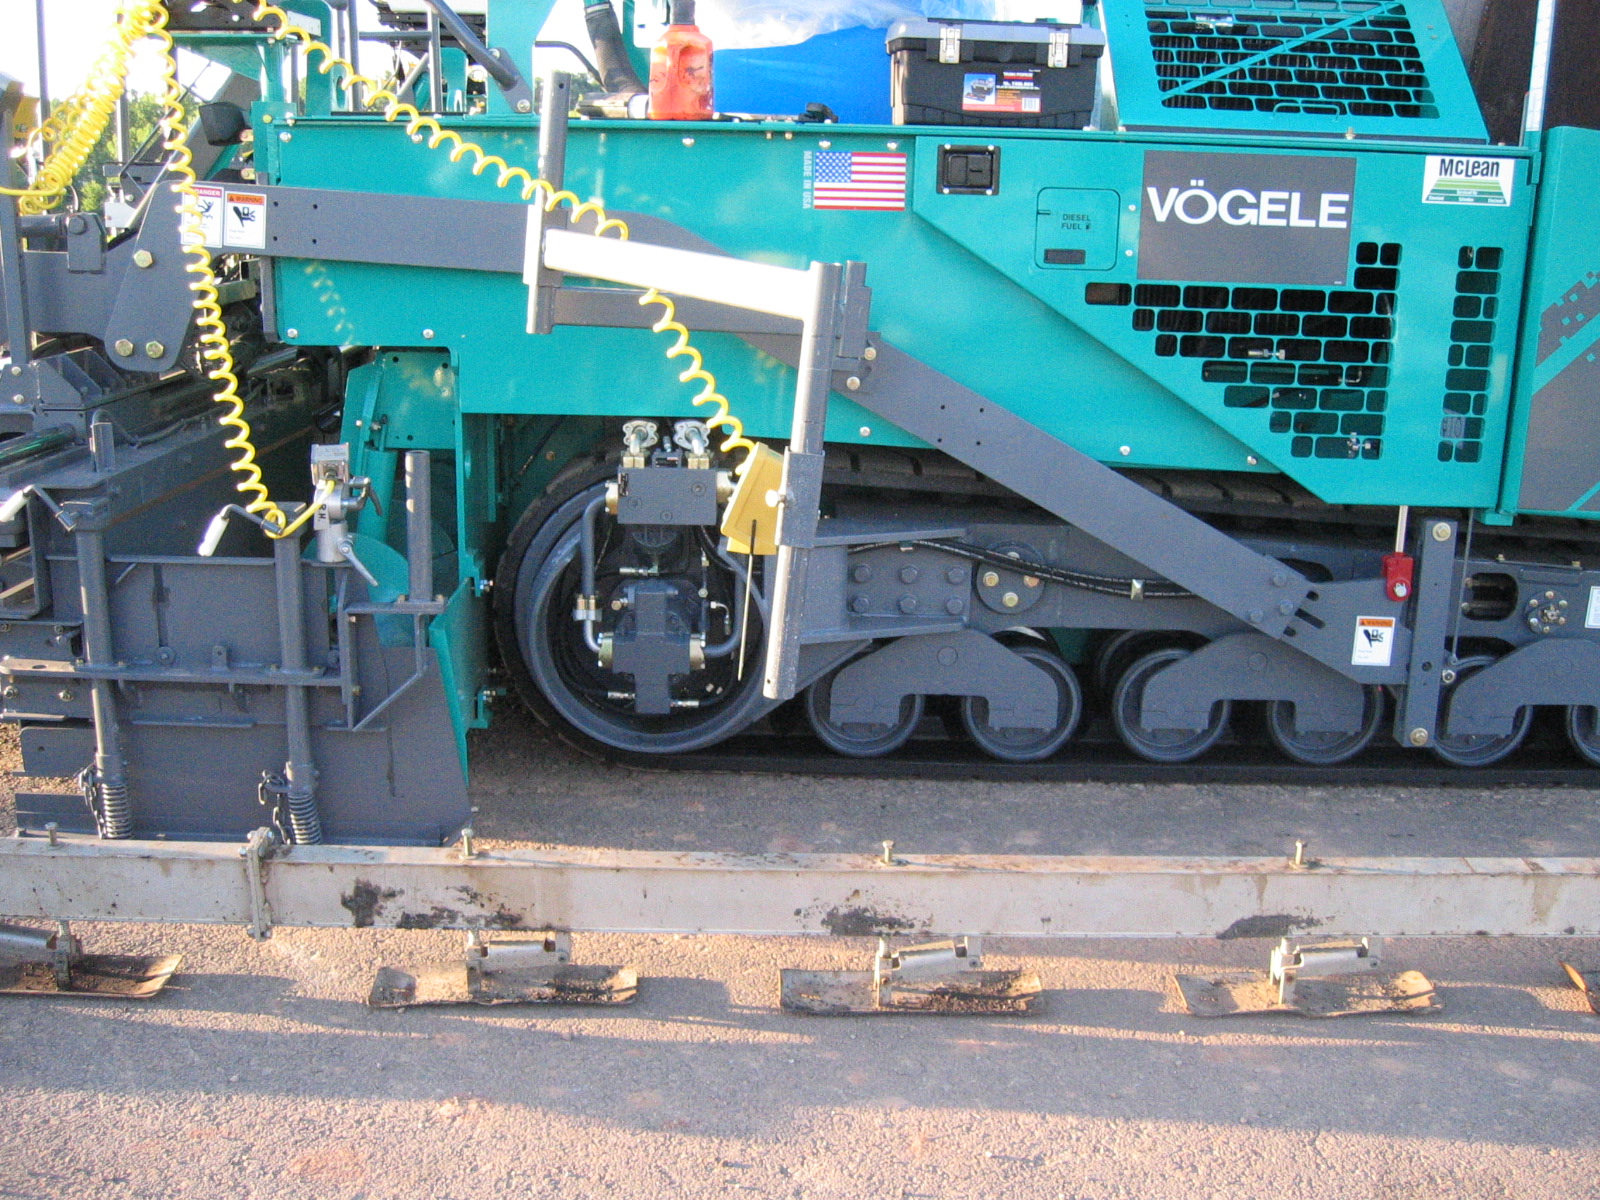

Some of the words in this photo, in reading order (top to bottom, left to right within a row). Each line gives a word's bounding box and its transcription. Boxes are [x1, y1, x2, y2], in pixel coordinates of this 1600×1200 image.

[803, 150, 812, 177] MADE
[1439, 158, 1500, 178] McLean
[803, 179, 812, 189] IN
[195, 187, 221, 197] DANGER
[236, 195, 263, 204] WARNING
[802, 191, 812, 209] USA
[1147, 179, 1350, 228] VÖGELE
[1063, 213, 1091, 221] DIESEL
[1061, 222, 1082, 230] FUEL
